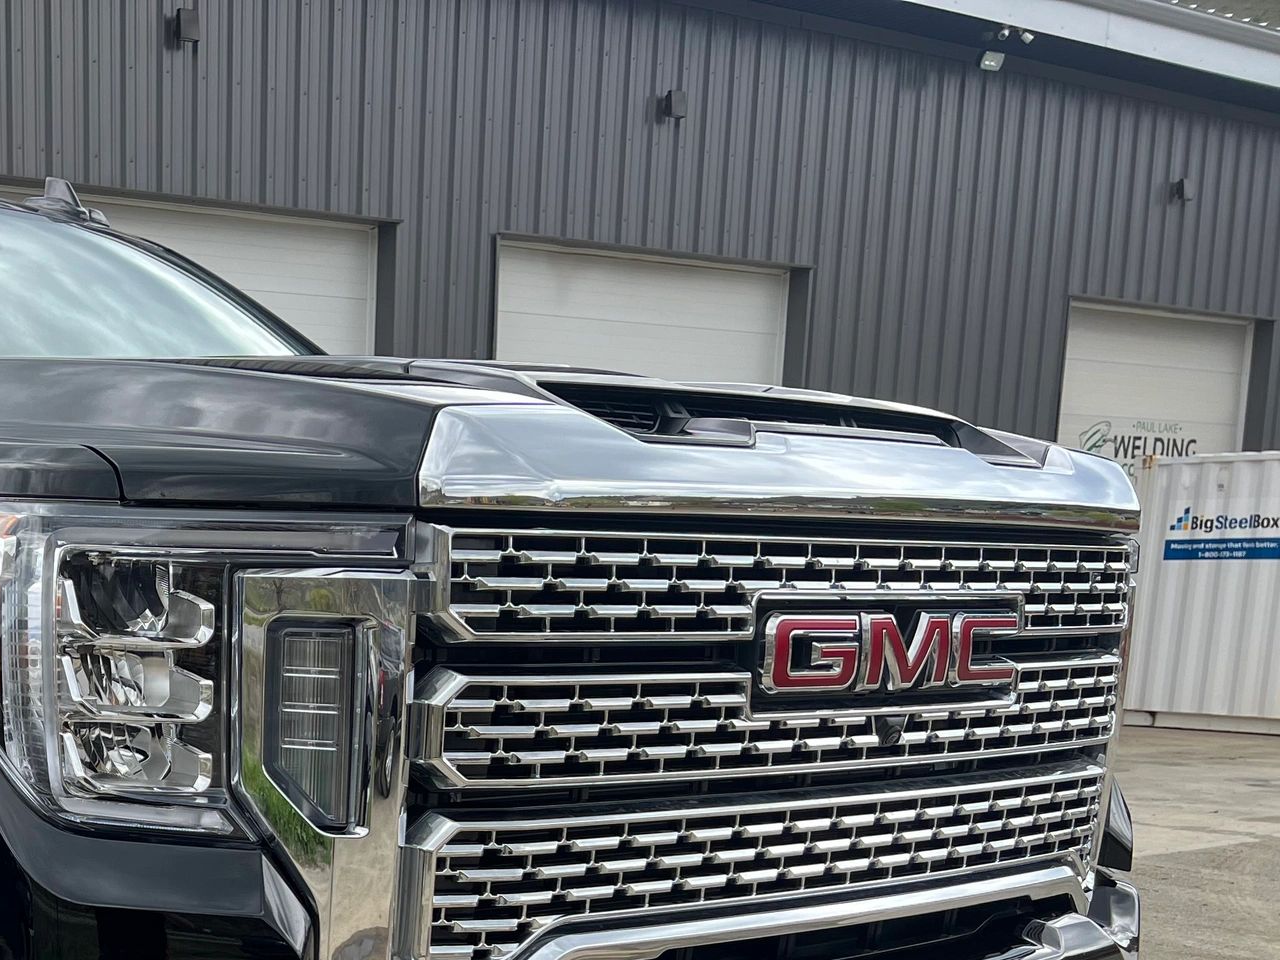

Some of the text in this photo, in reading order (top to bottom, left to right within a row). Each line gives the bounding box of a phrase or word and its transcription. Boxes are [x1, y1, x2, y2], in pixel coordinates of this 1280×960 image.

[1136, 421, 1179, 434] PAUL LAKE
[1114, 435, 1197, 459] WELDING
[1191, 514, 1280, 533] BigSteelBox
[761, 611, 1018, 694] GMC
